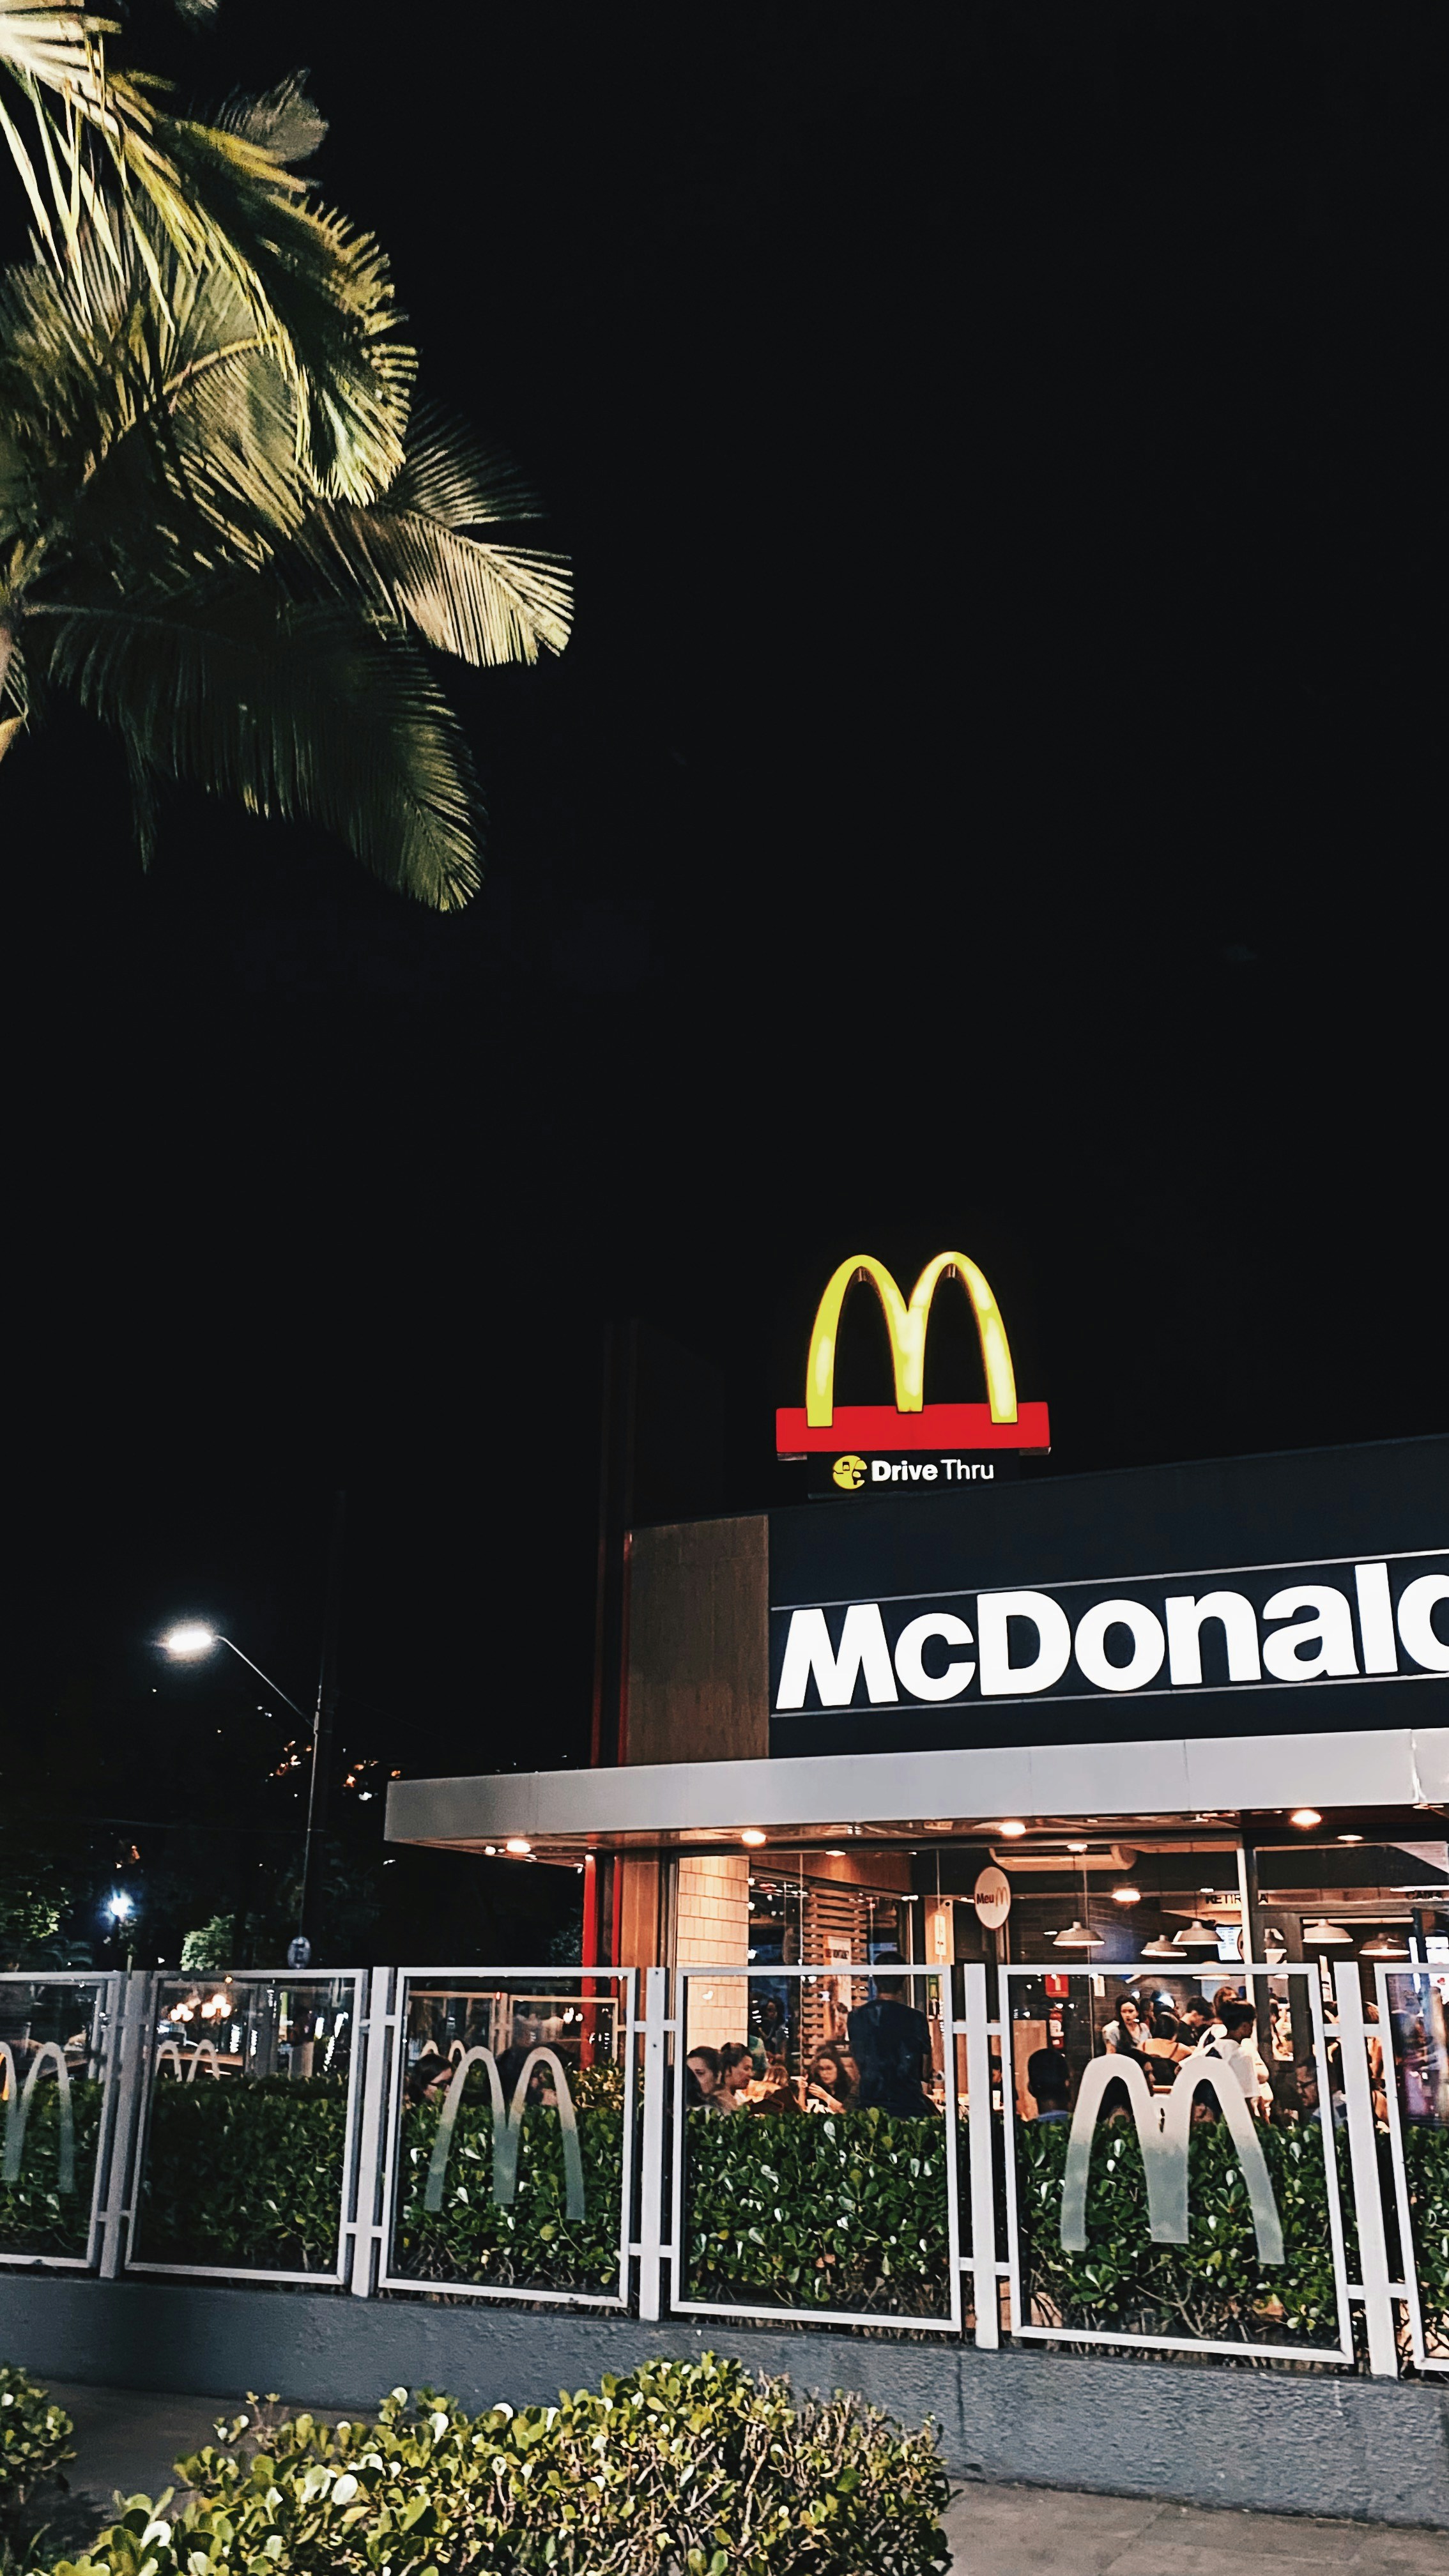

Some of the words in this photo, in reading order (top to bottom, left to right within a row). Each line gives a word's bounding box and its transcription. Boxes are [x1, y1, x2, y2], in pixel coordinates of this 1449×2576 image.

[871, 1460, 938, 1482] Drive
[940, 1459, 994, 1480] Thru
[977, 1893, 994, 1905] Meu
[1206, 1893, 1268, 1905] RETIRA
